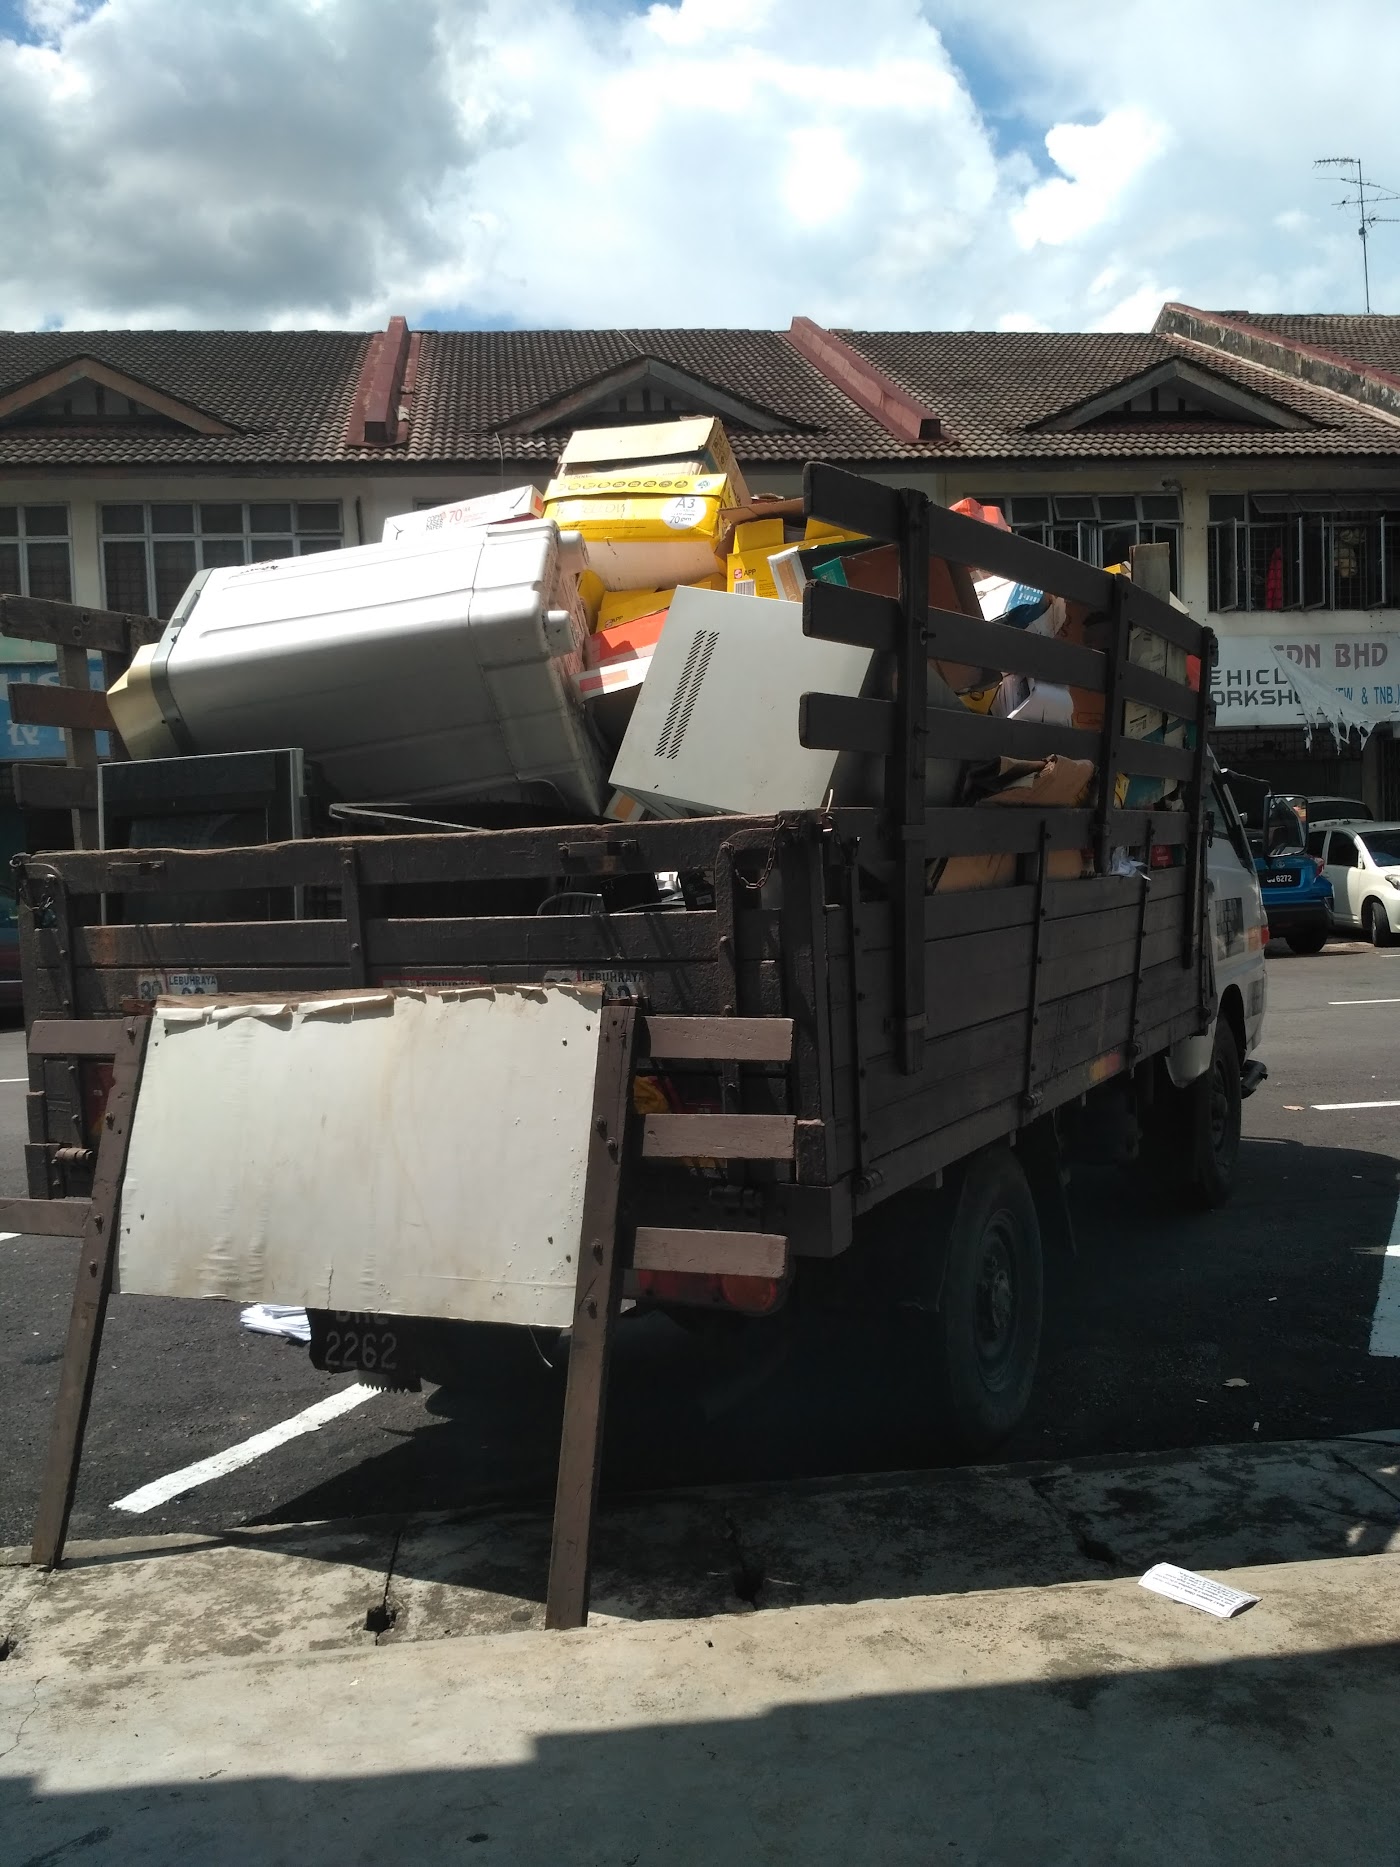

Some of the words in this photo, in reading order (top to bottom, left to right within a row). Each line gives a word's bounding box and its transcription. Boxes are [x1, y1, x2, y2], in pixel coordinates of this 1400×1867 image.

[675, 497, 696, 509] A3
[448, 509, 463, 523] 70
[743, 568, 757, 576] APP
[1335, 642, 1388, 670] BHD
[1361, 686, 1370, 705] &
[1275, 874, 1293, 883] 6272
[169, 975, 216, 986] LEBUHRAYA
[324, 1330, 398, 1370] 2262
